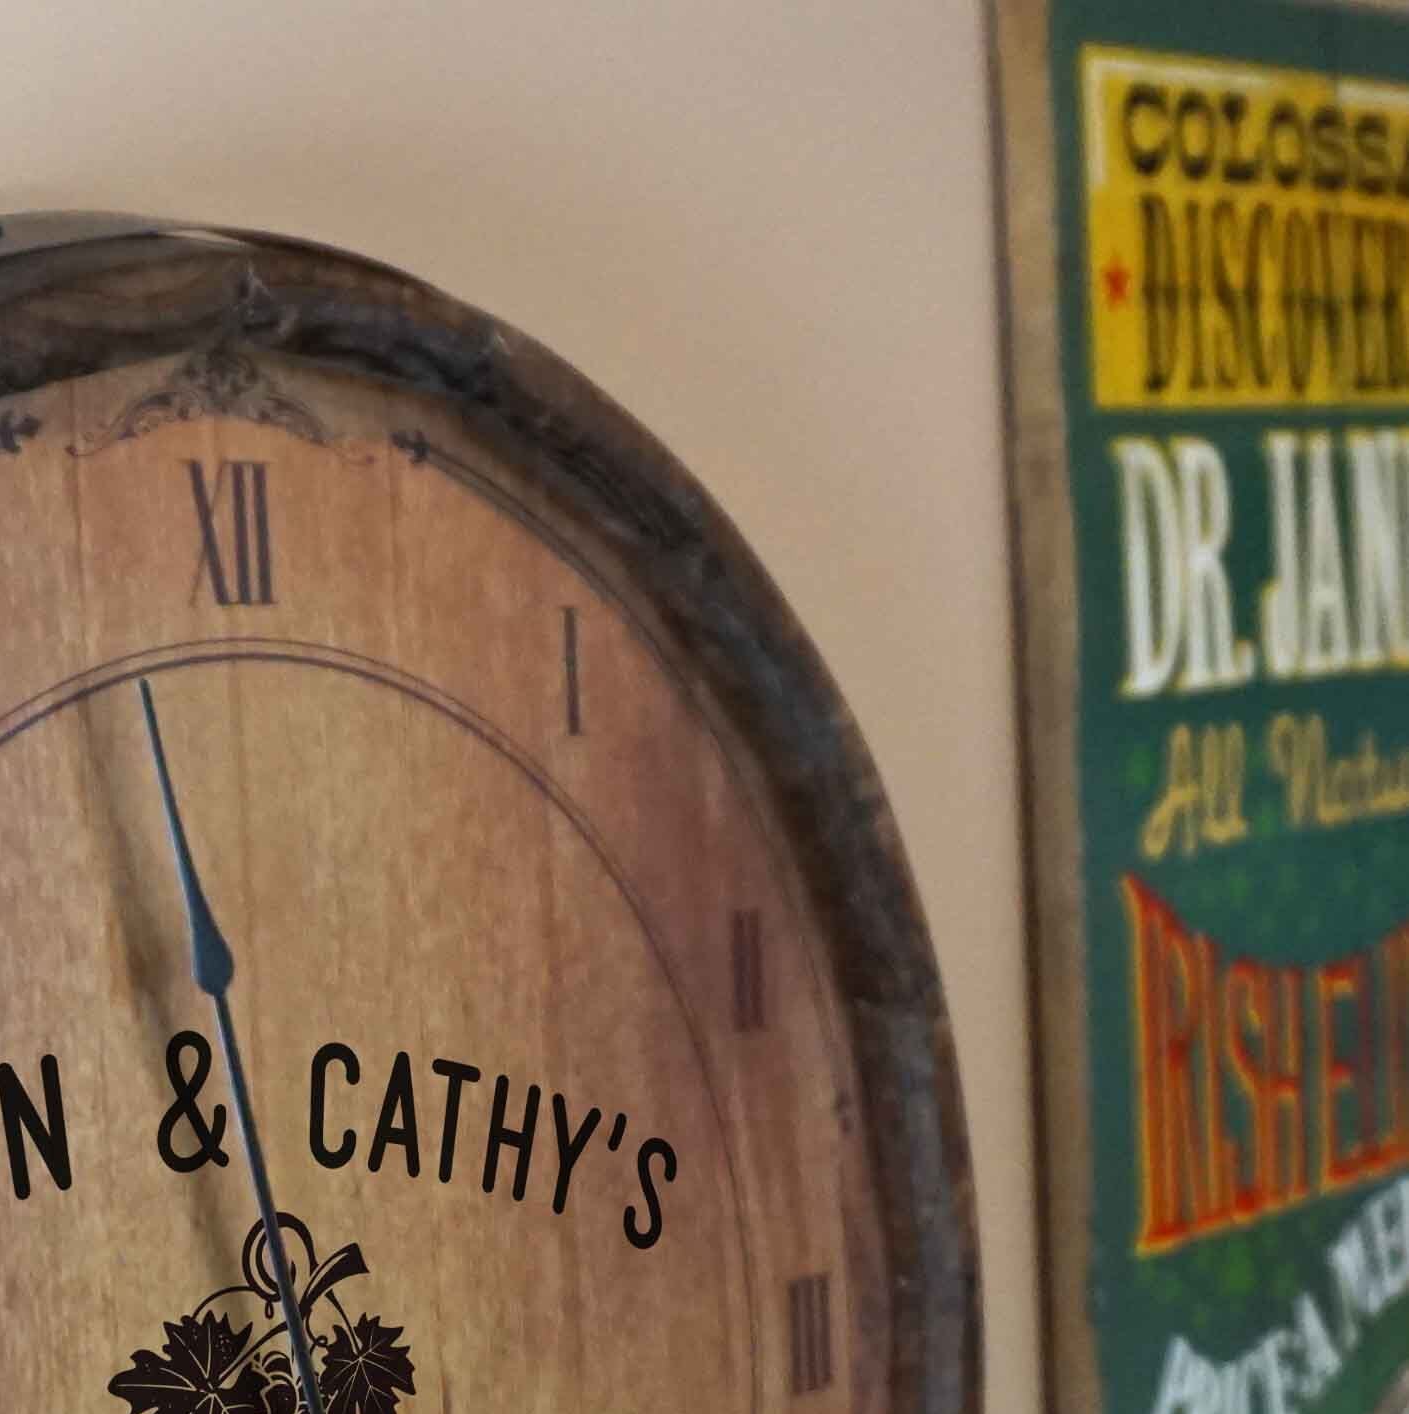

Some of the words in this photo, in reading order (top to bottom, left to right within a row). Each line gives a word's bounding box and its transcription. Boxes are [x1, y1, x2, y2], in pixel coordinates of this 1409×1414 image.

[1124, 82, 1409, 196] COLOSS
[188, 460, 277, 606] XII
[1111, 435, 1255, 697] DR.
[561, 605, 581, 736] I
[1140, 721, 1246, 862] All
[1267, 711, 1409, 830] Natu
[156, 1030, 230, 1174] &
[309, 1042, 678, 1250] CATHY'S
